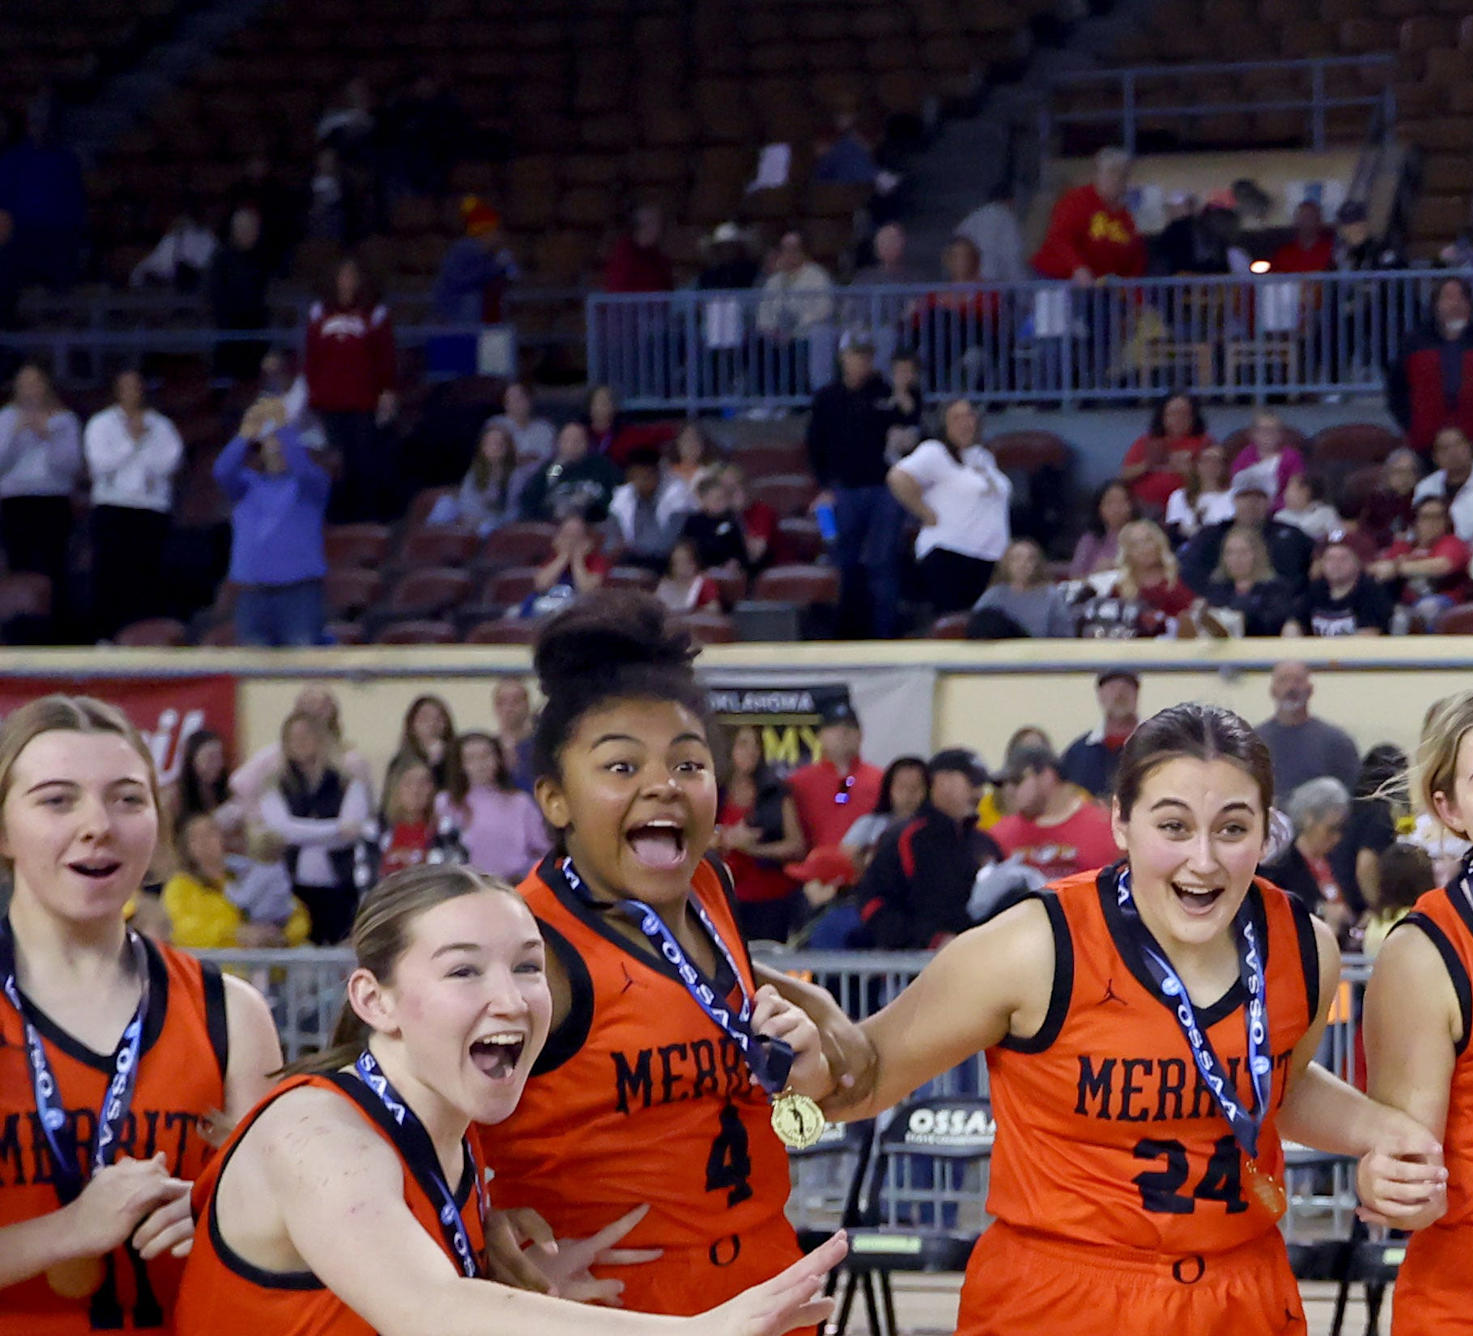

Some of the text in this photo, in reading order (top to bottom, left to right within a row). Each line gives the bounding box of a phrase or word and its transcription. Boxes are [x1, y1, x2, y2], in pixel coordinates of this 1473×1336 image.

[1177, 1003, 1240, 1123] OSSAA
[705, 1103, 754, 1208] 4
[1131, 1134, 1249, 1215] 24
[1171, 1255, 1206, 1285] O
